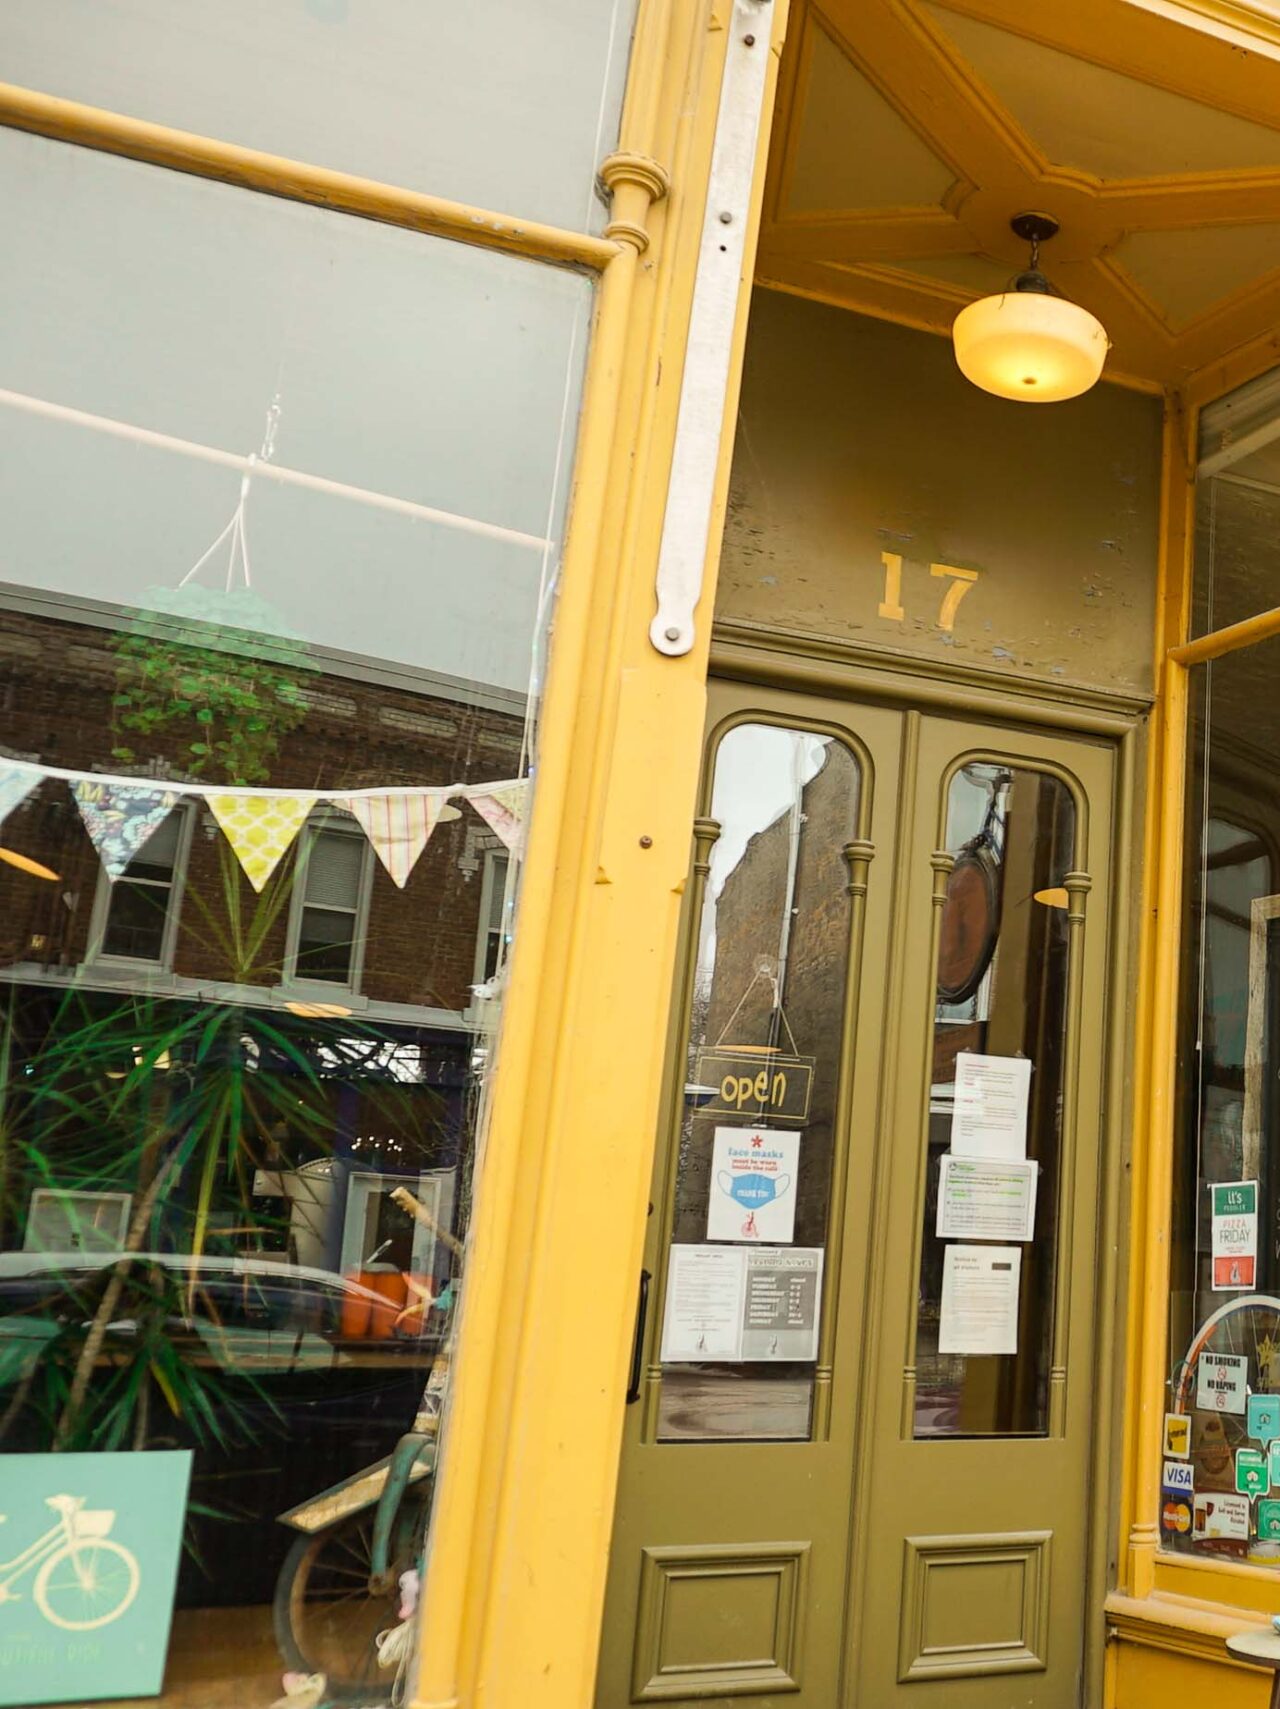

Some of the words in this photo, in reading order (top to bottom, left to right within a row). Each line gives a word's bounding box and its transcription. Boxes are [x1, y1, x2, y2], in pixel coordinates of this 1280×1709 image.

[878, 551, 978, 632] 17
[721, 1071, 787, 1110] open
[1220, 1229, 1249, 1243] FRIDAY
[1205, 1355, 1213, 1365] NO
[1214, 1356, 1241, 1368] SMOKING
[1207, 1380, 1215, 1389] NO
[1216, 1381, 1236, 1392] VAPING
[1167, 1468, 1191, 1485] VISA
